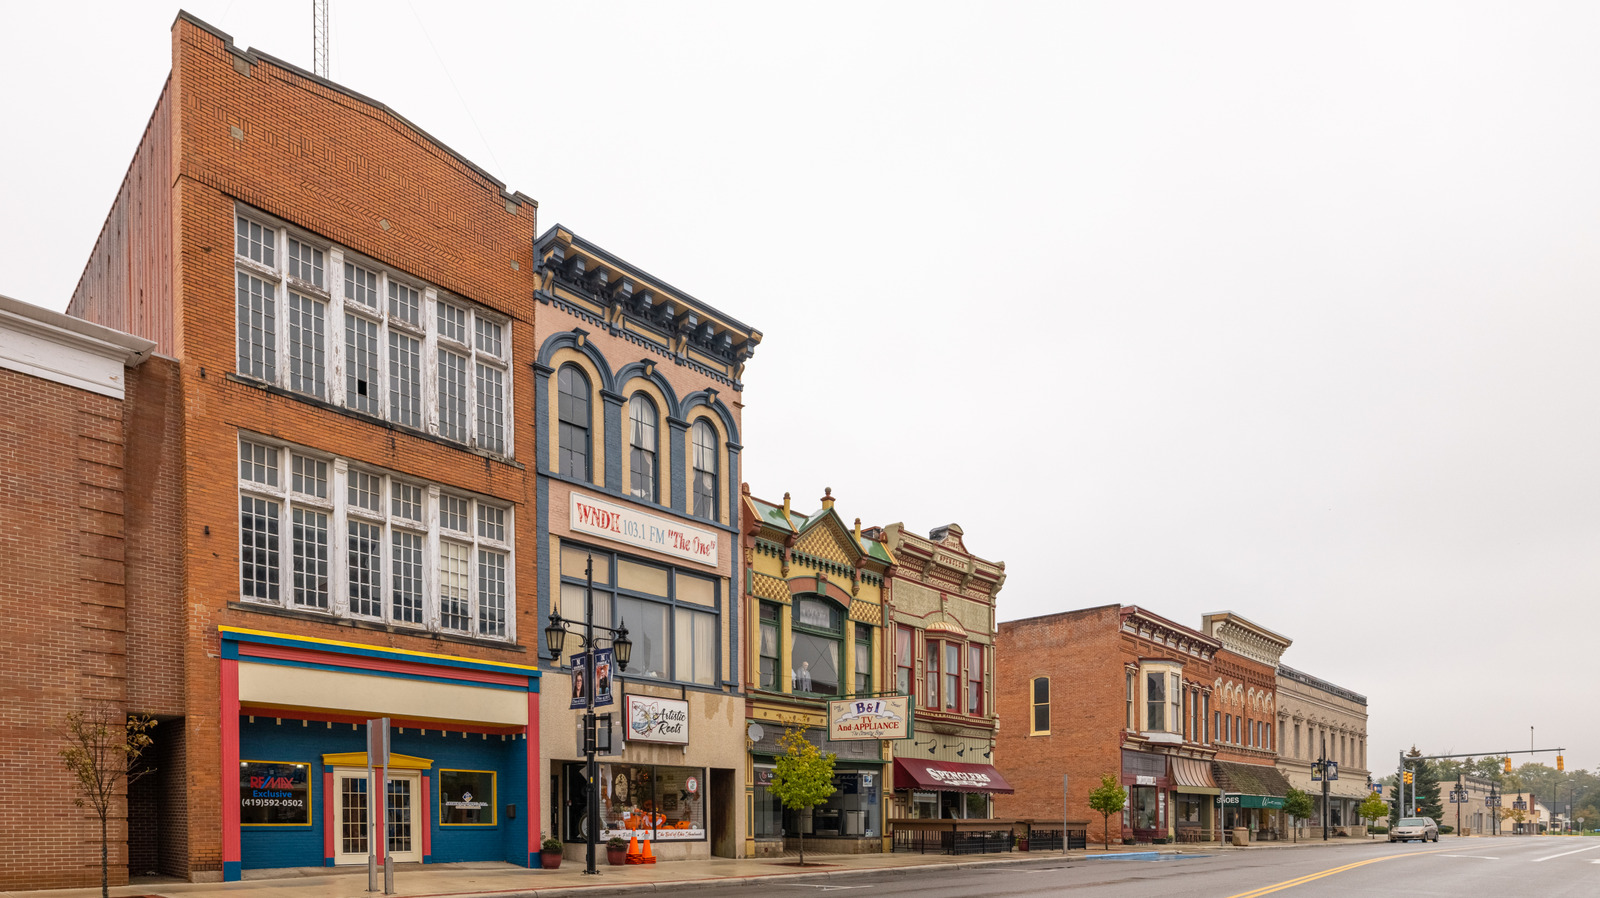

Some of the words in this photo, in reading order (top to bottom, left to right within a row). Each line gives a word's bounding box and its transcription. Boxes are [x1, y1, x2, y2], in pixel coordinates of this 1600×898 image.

[576, 502, 621, 533] WNDH
[624, 520, 646, 540] 103.1
[649, 525, 665, 545] FM
[667, 529, 691, 552] "The
[693, 536, 716, 557] One"
[653, 708, 686, 721] Artistic
[861, 716, 873, 724] TV
[657, 720, 683, 735] Roots
[837, 724, 852, 732] And
[854, 721, 900, 731] APPLIANCE
[926, 767, 991, 783] SPENGLERS
[250, 776, 294, 789] RE/MAX
[252, 790, 293, 798] Exclusive
[241, 798, 303, 807] (419)592-0502
